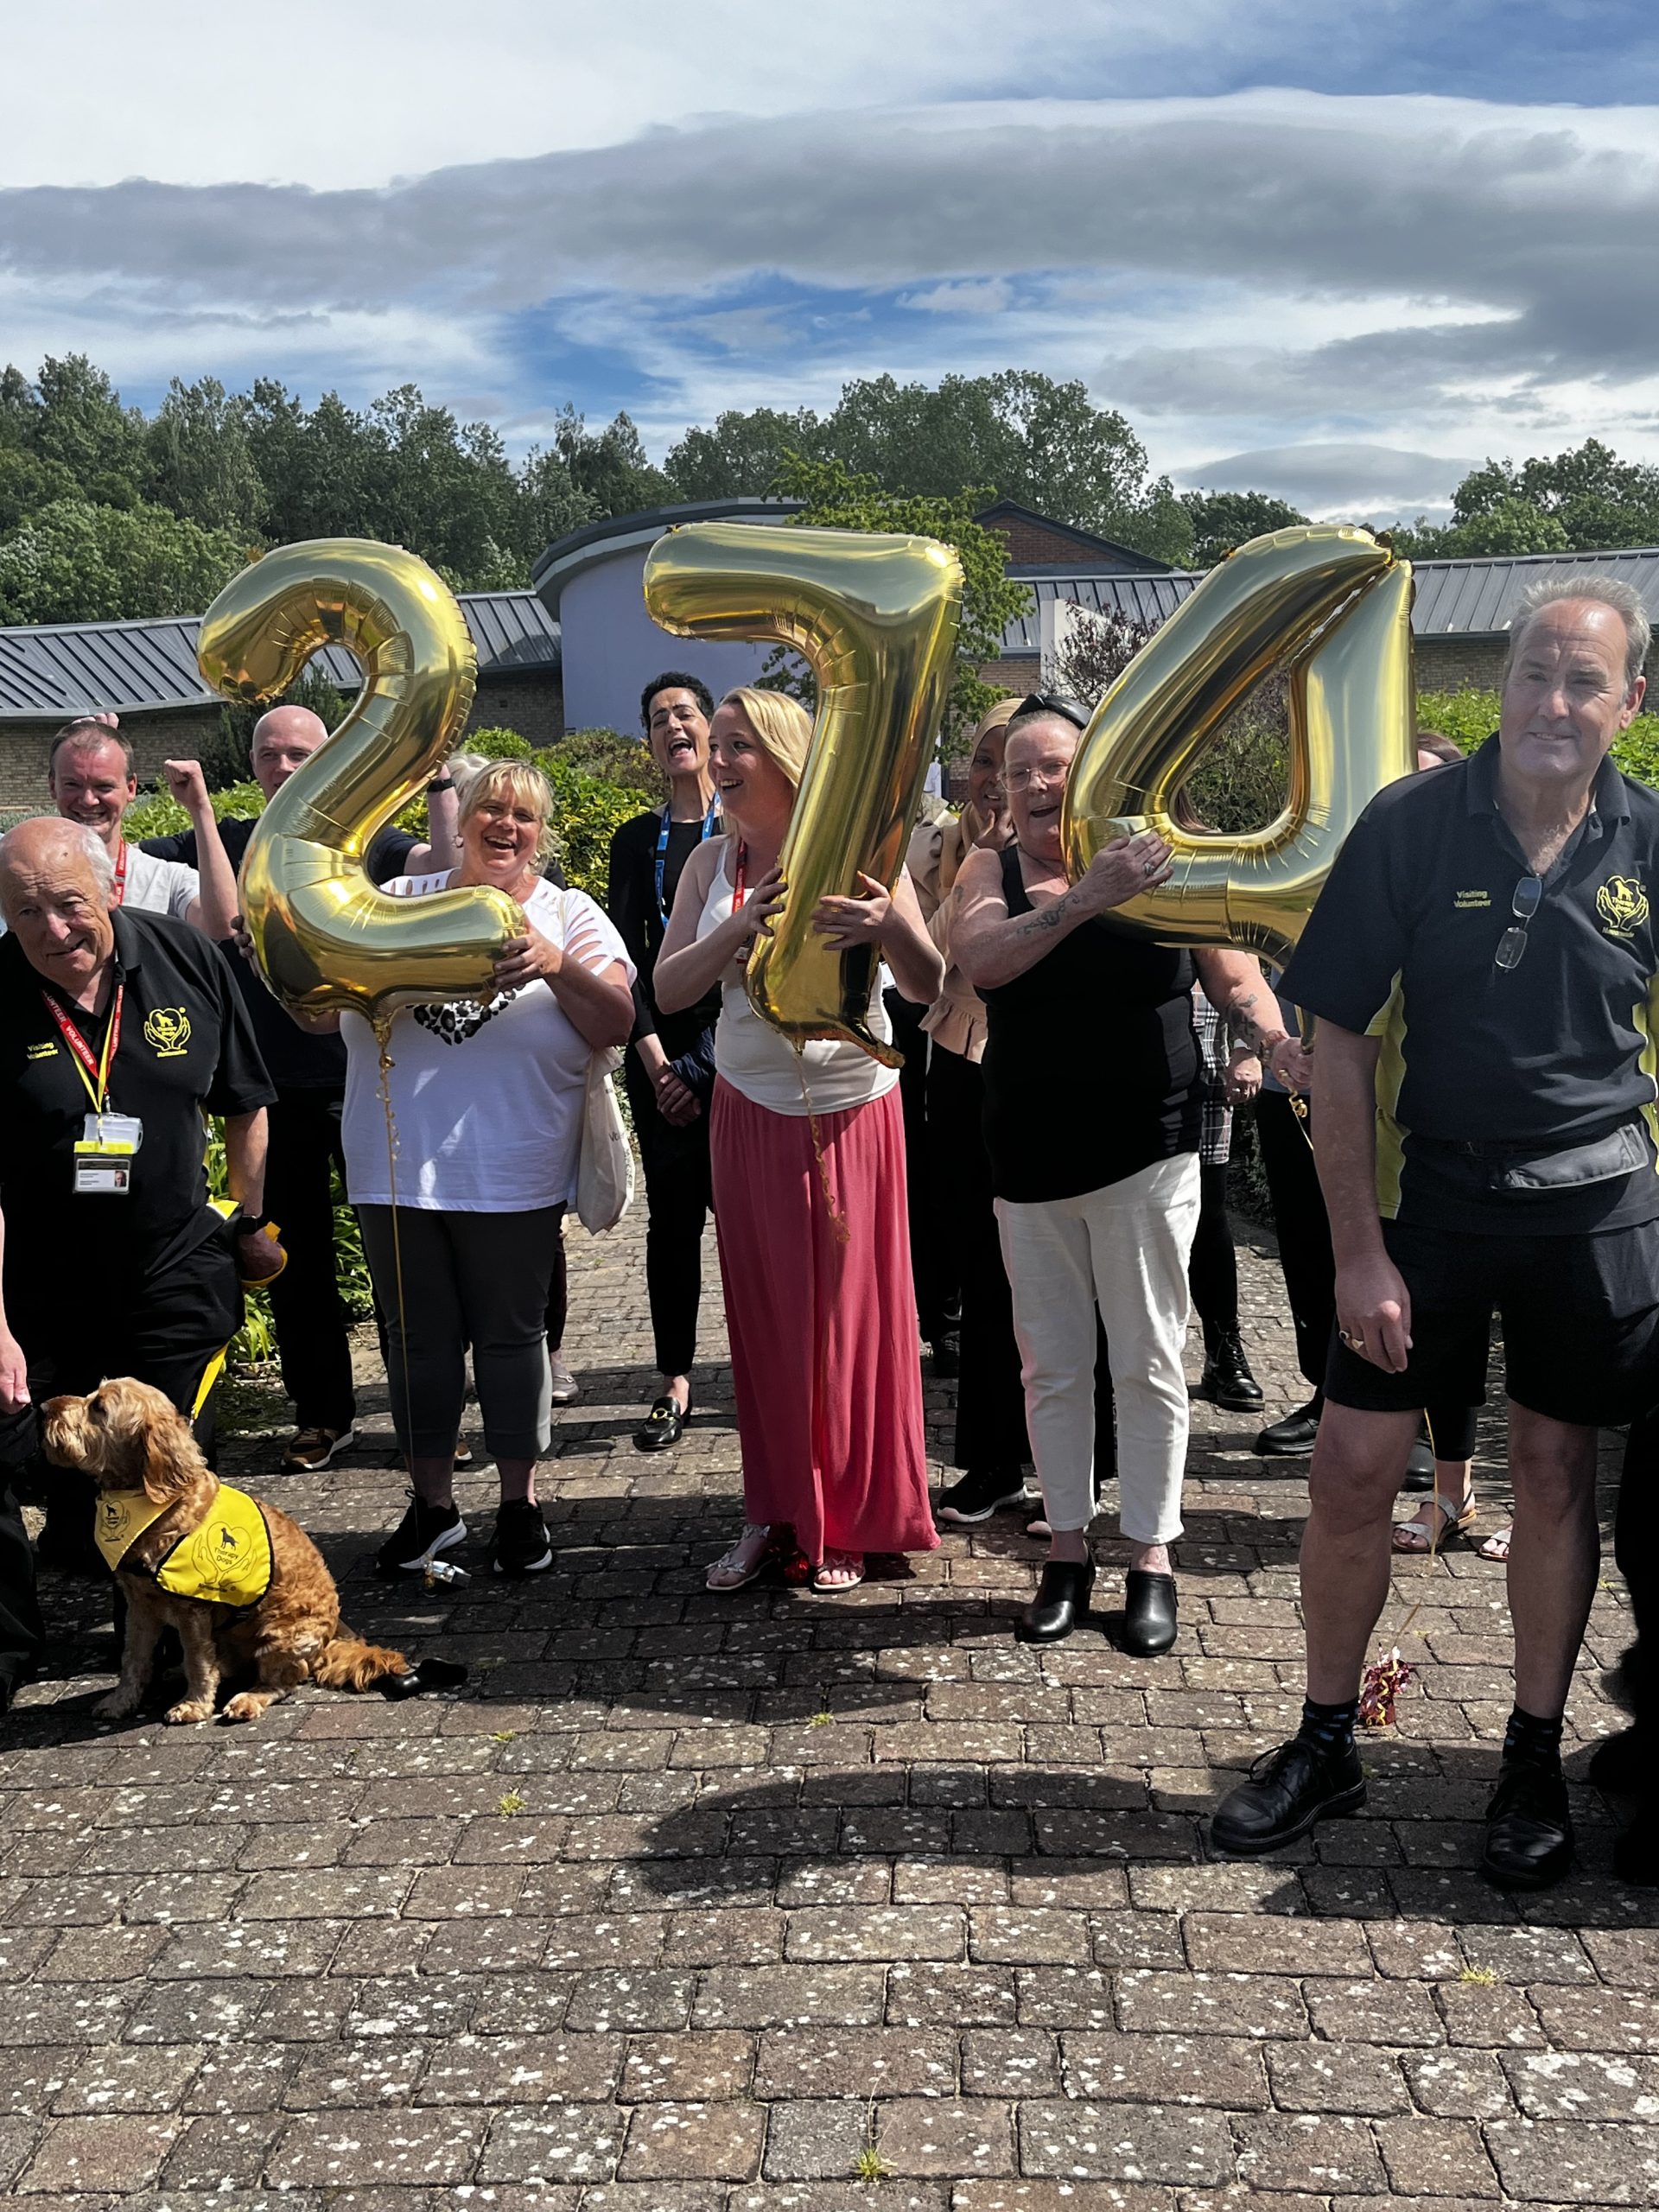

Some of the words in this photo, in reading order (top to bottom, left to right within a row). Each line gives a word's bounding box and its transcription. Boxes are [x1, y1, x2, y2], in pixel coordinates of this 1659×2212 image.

[198, 537, 525, 1020] 2
[643, 522, 966, 1068] 7
[1061, 524, 1420, 976] 4
[66, 1025, 95, 1065] VOLUNTEER
